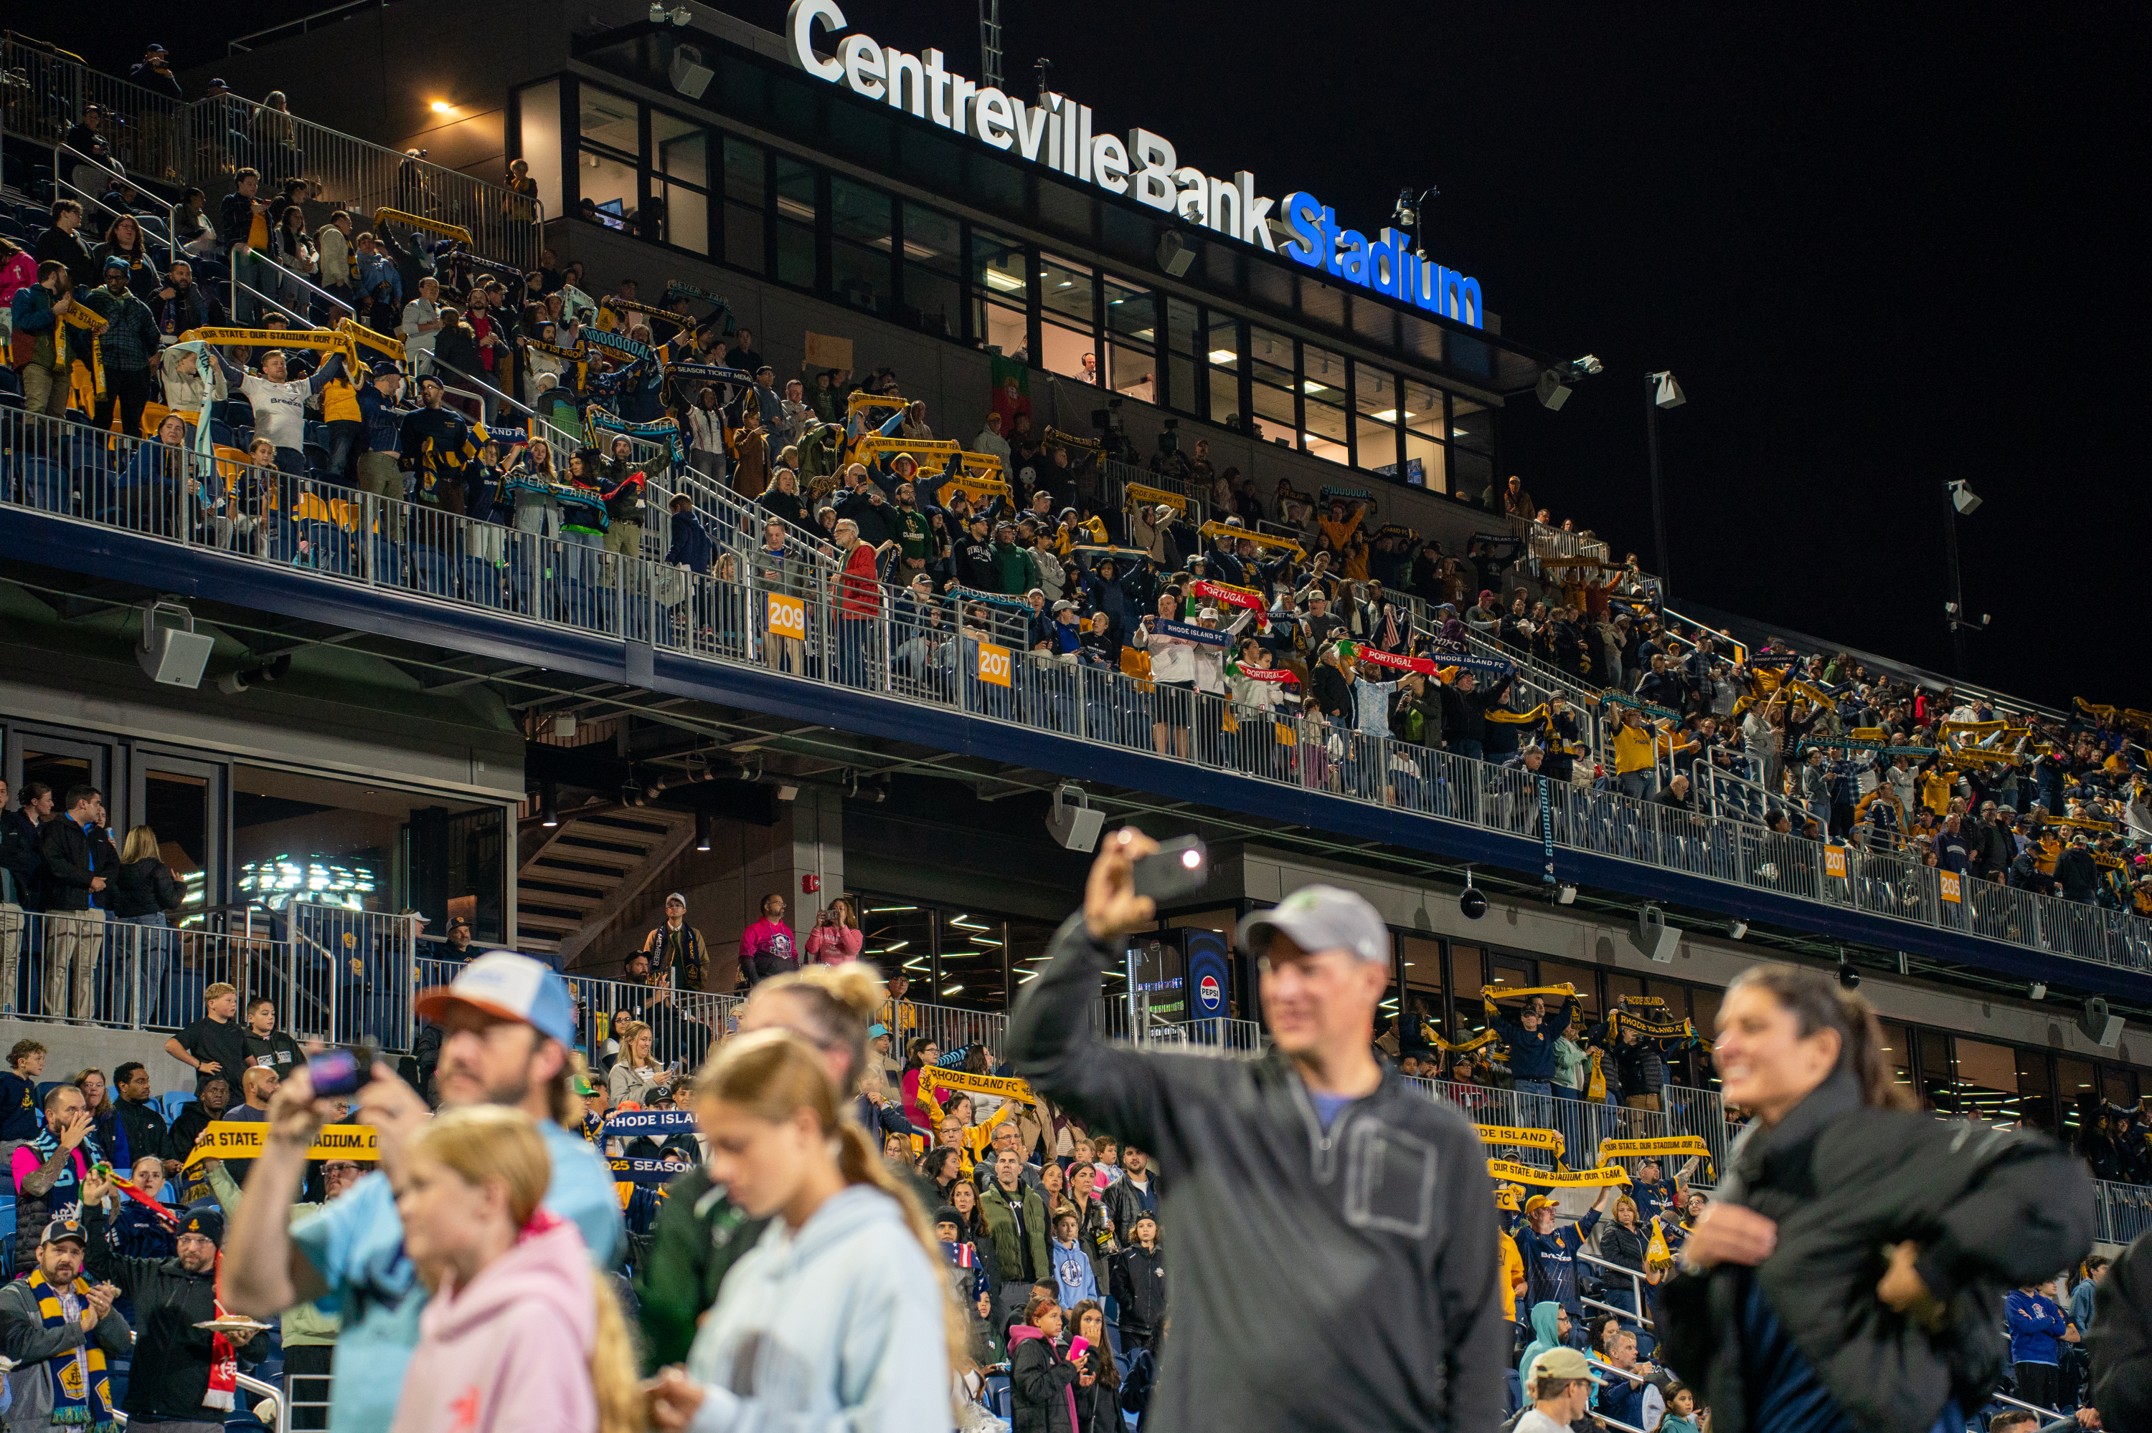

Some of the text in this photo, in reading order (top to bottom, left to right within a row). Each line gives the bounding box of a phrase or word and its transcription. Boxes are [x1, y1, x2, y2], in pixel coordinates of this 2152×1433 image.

[1282, 191, 1484, 329] Stadium
[644, 305, 681, 320] ISLAND
[201, 330, 349, 347] OUR STATE. OUR STADIUM. OUR TEA
[678, 367, 706, 375] SEASON
[707, 369, 731, 378] TICKET
[488, 428, 512, 437] LAND
[876, 439, 894, 447] STATE.
[895, 439, 907, 447] OUR
[908, 440, 935, 448] STADIUM.
[936, 441, 947, 449] OUR
[949, 442, 960, 450] TEA
[1149, 492, 1172, 503] ISLAND
[1174, 497, 1183, 506] FC
[996, 593, 1030, 607] ISLAN
[1202, 584, 1247, 605] PORTUGAL
[769, 601, 804, 630] 209
[1168, 624, 1223, 642] RHODE ISLAND FC
[980, 651, 1010, 677] 207
[1368, 650, 1412, 668] PORTUGAL
[1435, 654, 1505, 669] RHODE ISLAND FC
[1246, 668, 1280, 679] PORTUGAL
[1806, 735, 1885, 749] HODE ISLAN
[1826, 852, 1845, 871] 207
[2096, 855, 2117, 866] AND
[1942, 877, 1960, 897] 205
[1201, 987, 1218, 997] PEPSI
[1625, 995, 1664, 1006] RHODE ISLAND
[1620, 1014, 1647, 1031] RHODE
[1675, 1024, 1683, 1033] FC
[930, 1069, 1018, 1092] RHODE ISLAND FC
[606, 1112, 699, 1128] RHODE ISLA
[220, 1131, 263, 1146] STATE.
[308, 1134, 364, 1148] ADIUM.
[1500, 1130, 1547, 1143] ISLAND
[1550, 1136, 1563, 1151] FC
[1604, 1140, 1707, 1151] OUR STATE. OUR STADIUM. OUR TEA
[603, 1160, 697, 1173] 025 SEASON
[1493, 1162, 1622, 1182] OUR STATE. OUR STADIUM. OUR TEAM.
[1497, 1192, 1510, 1206] FC
